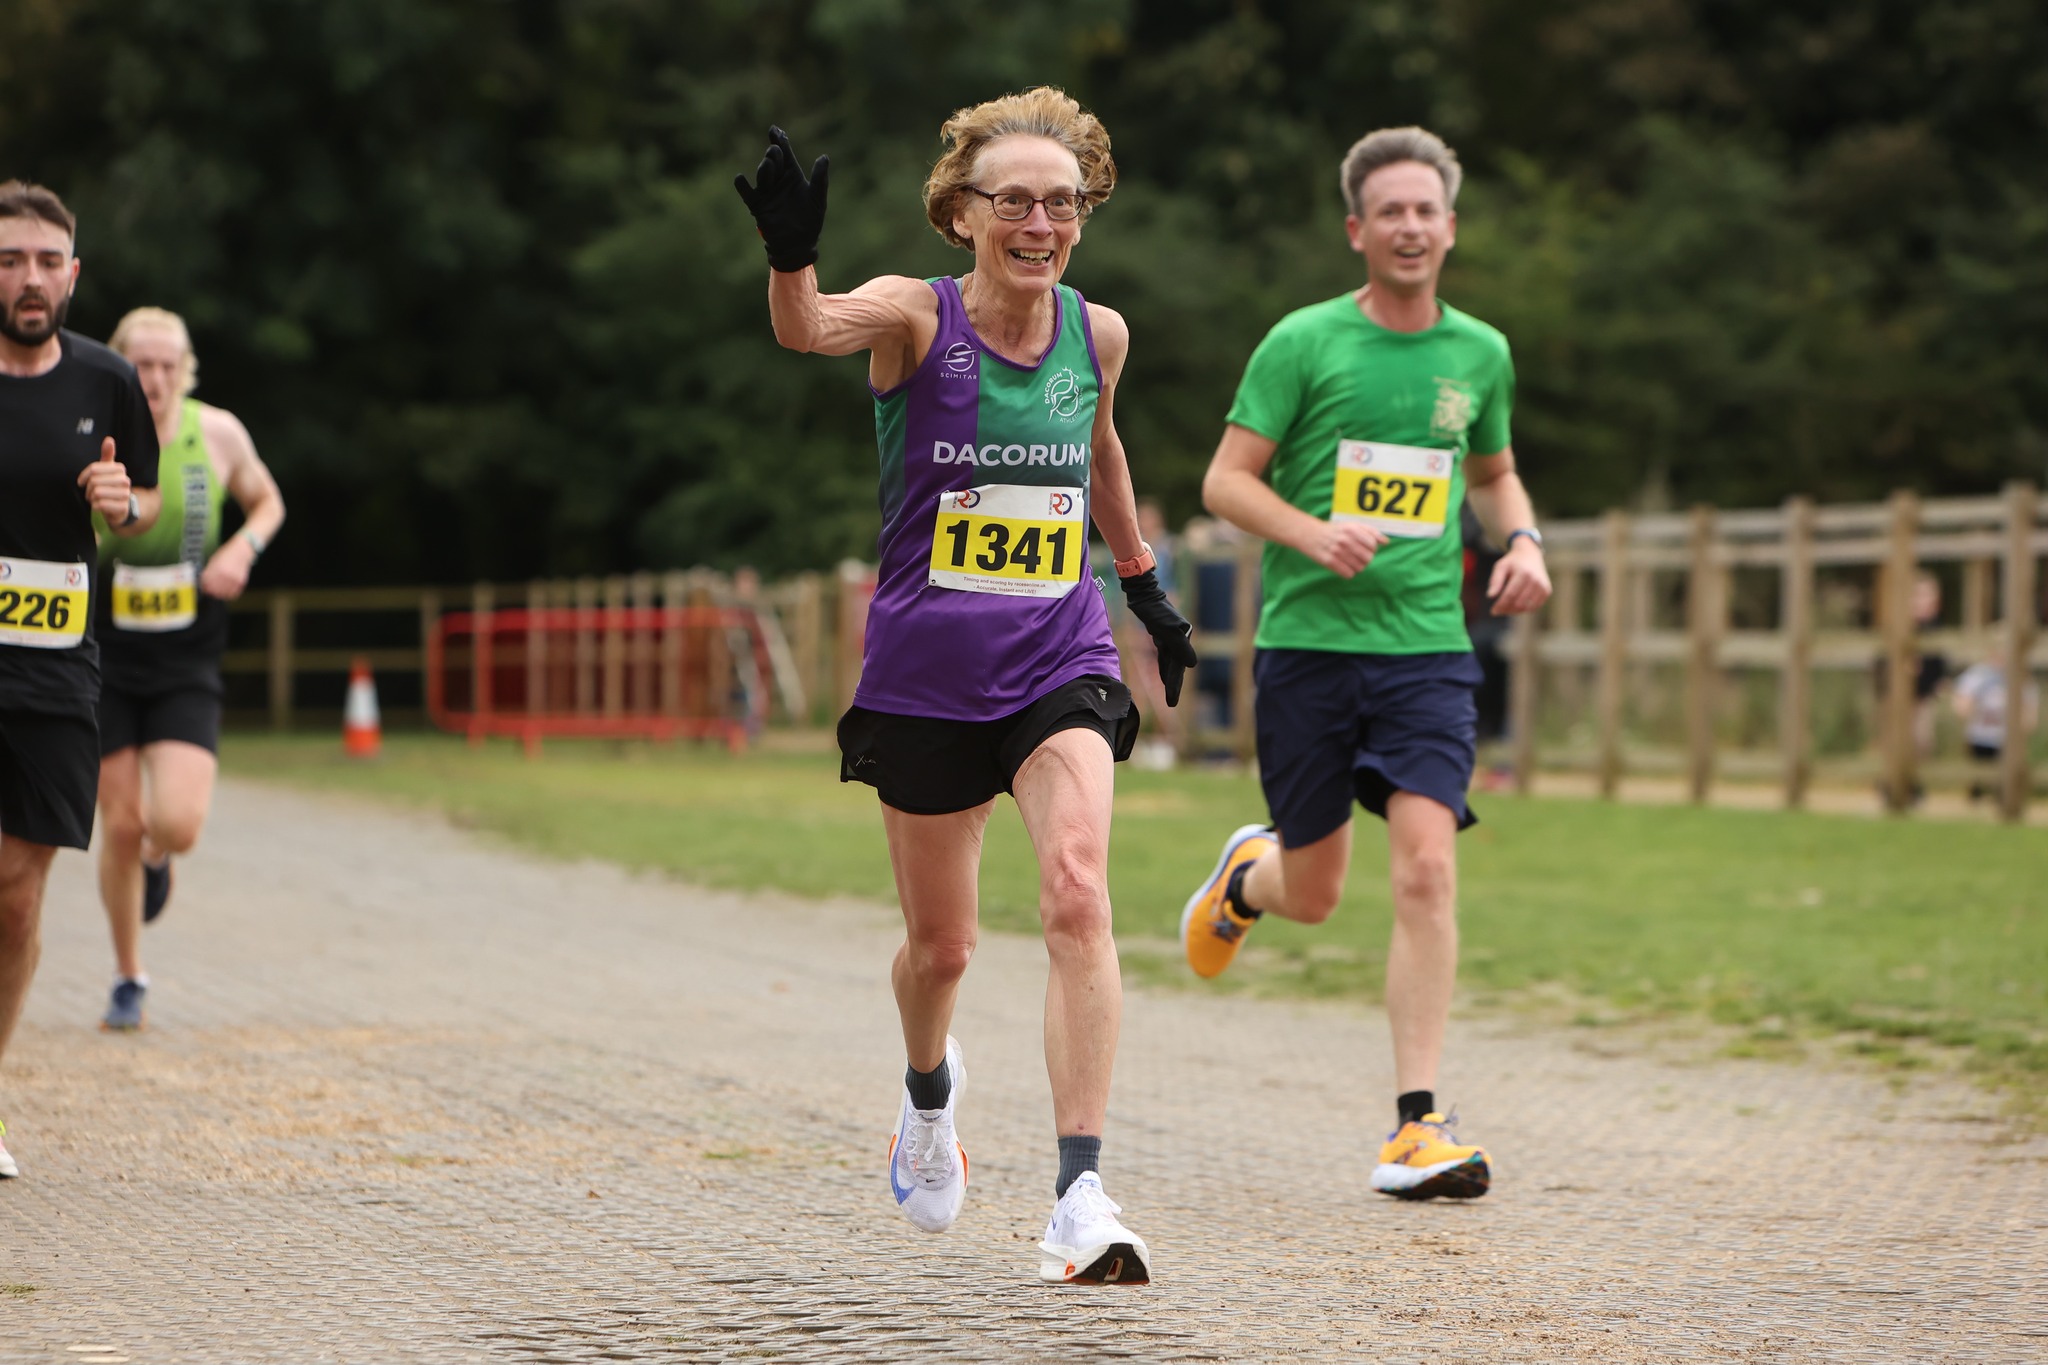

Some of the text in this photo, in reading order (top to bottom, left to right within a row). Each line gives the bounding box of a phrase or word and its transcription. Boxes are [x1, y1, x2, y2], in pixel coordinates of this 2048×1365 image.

[940, 372, 977, 380] SCIMITAR
[1044, 372, 1063, 404] DACORUM
[933, 440, 1085, 466] DACORUM
[1357, 475, 1432, 517] 627
[946, 519, 1068, 575] 1341
[990, 579, 1007, 587] scoring
[0, 590, 71, 630] 226
